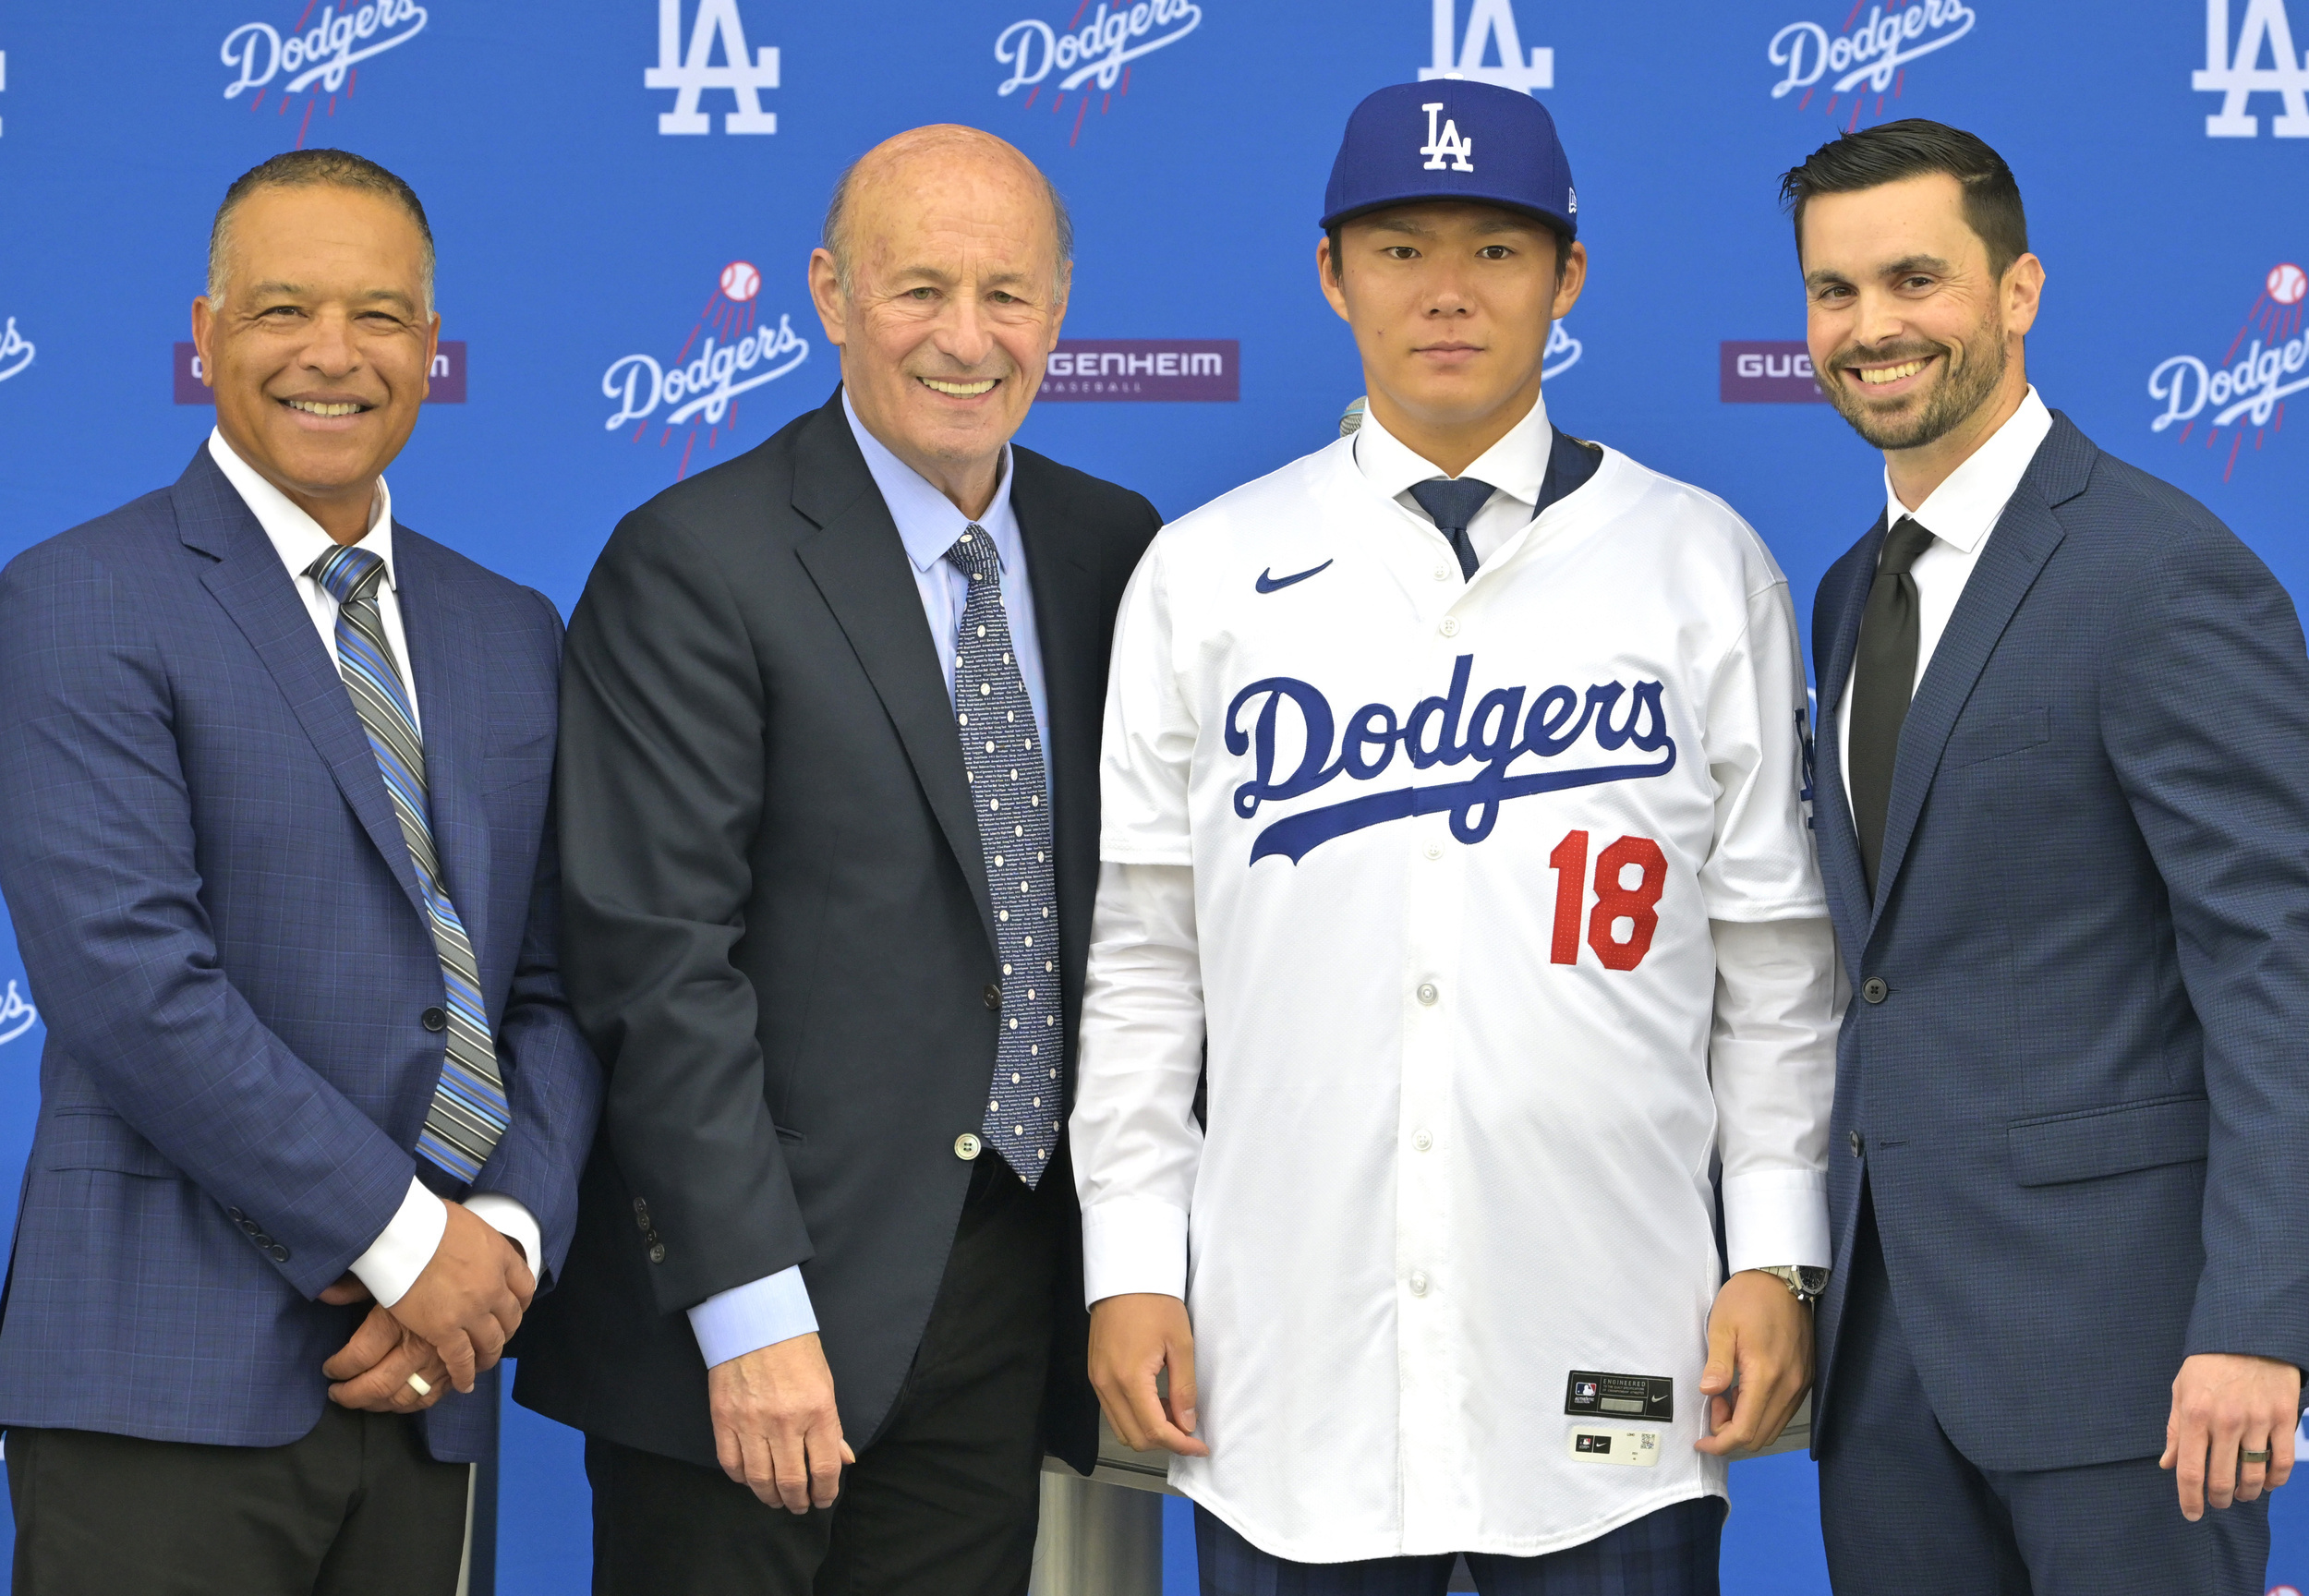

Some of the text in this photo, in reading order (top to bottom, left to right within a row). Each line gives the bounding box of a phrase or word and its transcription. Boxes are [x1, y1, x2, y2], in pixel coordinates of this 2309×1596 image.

[644, 0, 780, 135] LA
[1420, 103, 1474, 173] LA
[602, 313, 809, 430] Dodgers
[1041, 381, 1142, 393] BASEBALL
[1225, 654, 1676, 867] Dodgers
[1549, 829, 1668, 972] 18
[1602, 1378, 1646, 1387] ENGINEERED
